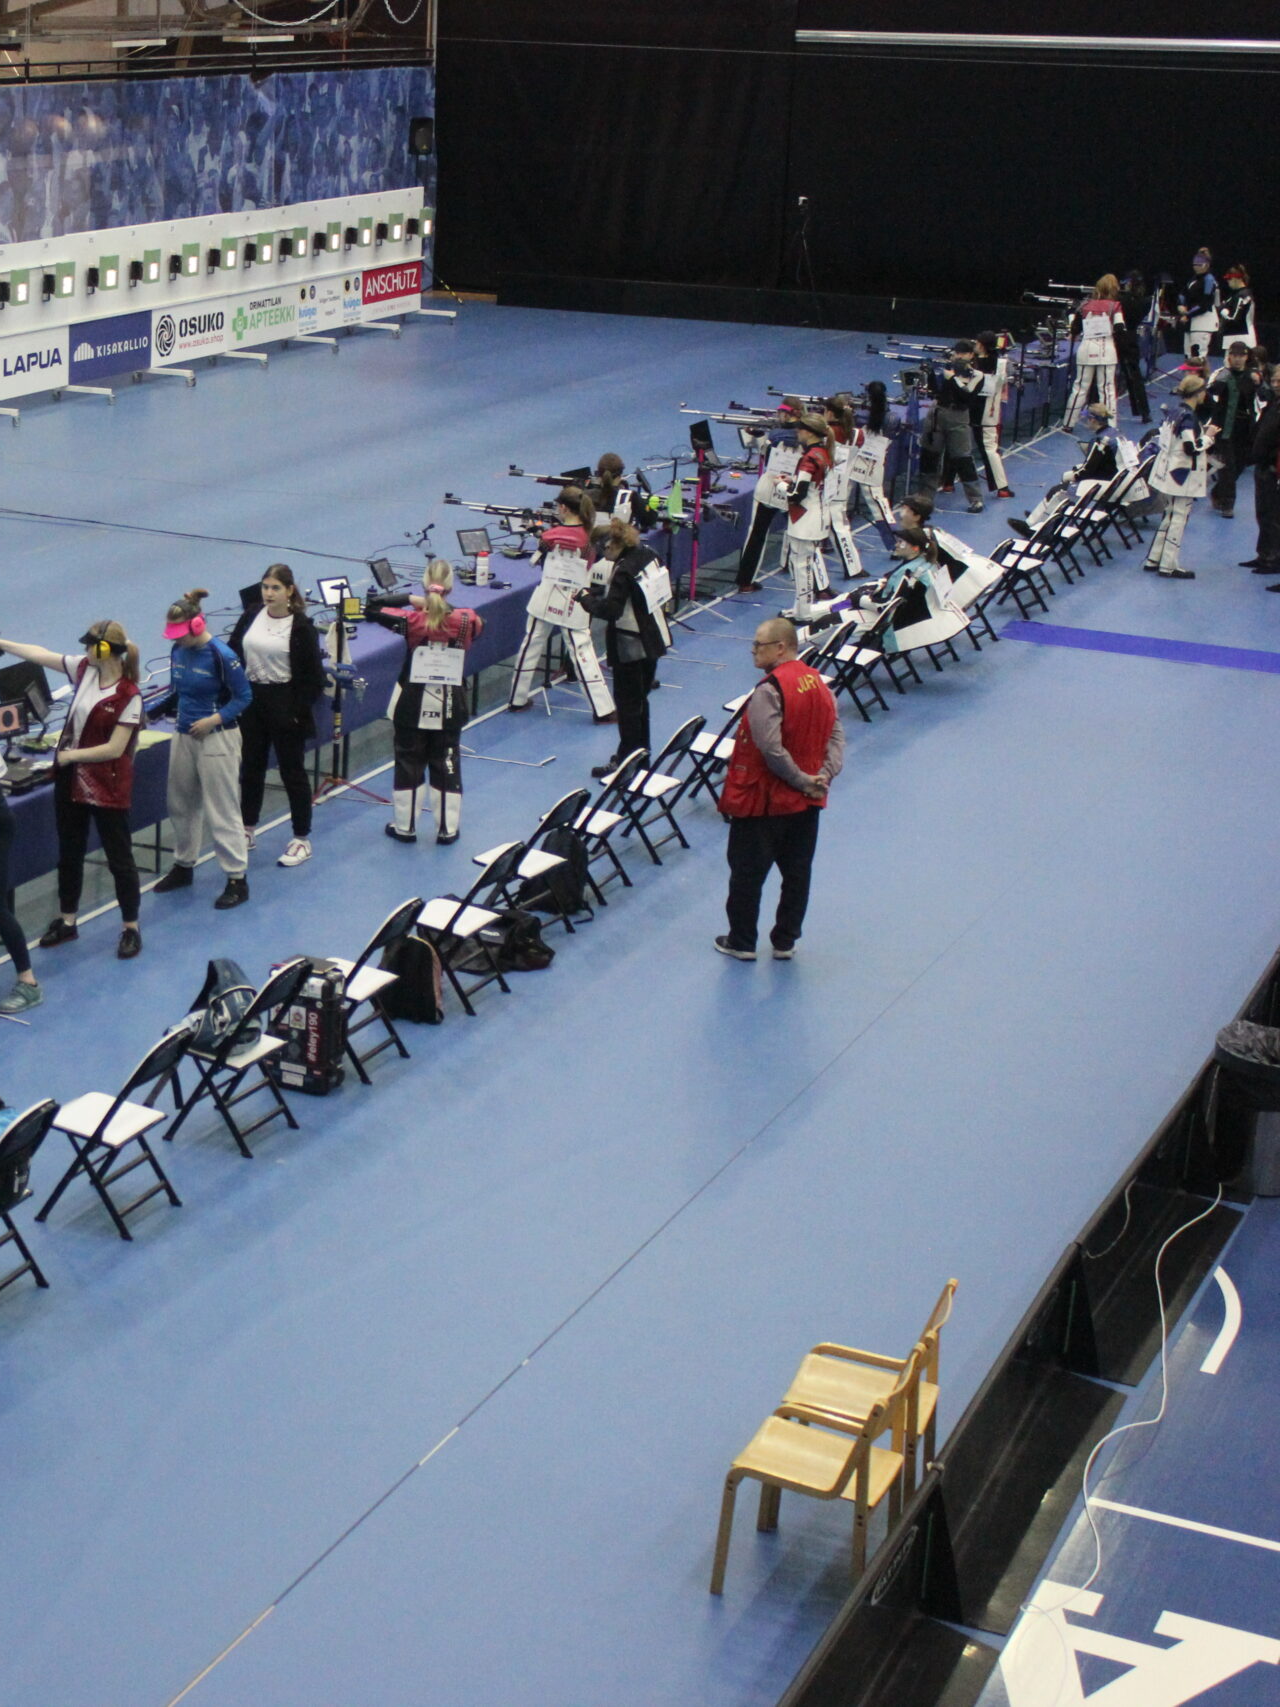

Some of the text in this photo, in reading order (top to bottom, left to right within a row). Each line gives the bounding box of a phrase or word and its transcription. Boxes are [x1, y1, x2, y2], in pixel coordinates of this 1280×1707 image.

[365, 268, 418, 298] ANSCHÜTZ
[249, 297, 282, 311] ORIMATTILAN
[179, 311, 224, 338] OSUKO
[249, 306, 296, 330] APTEEKKI
[96, 336, 149, 359] KISAKALLIO
[3, 348, 62, 376] LAPUA
[592, 572, 604, 581] IN
[547, 605, 564, 617] NOR
[422, 710, 441, 718] FIN
[307, 1012, 319, 1061] #eley190
